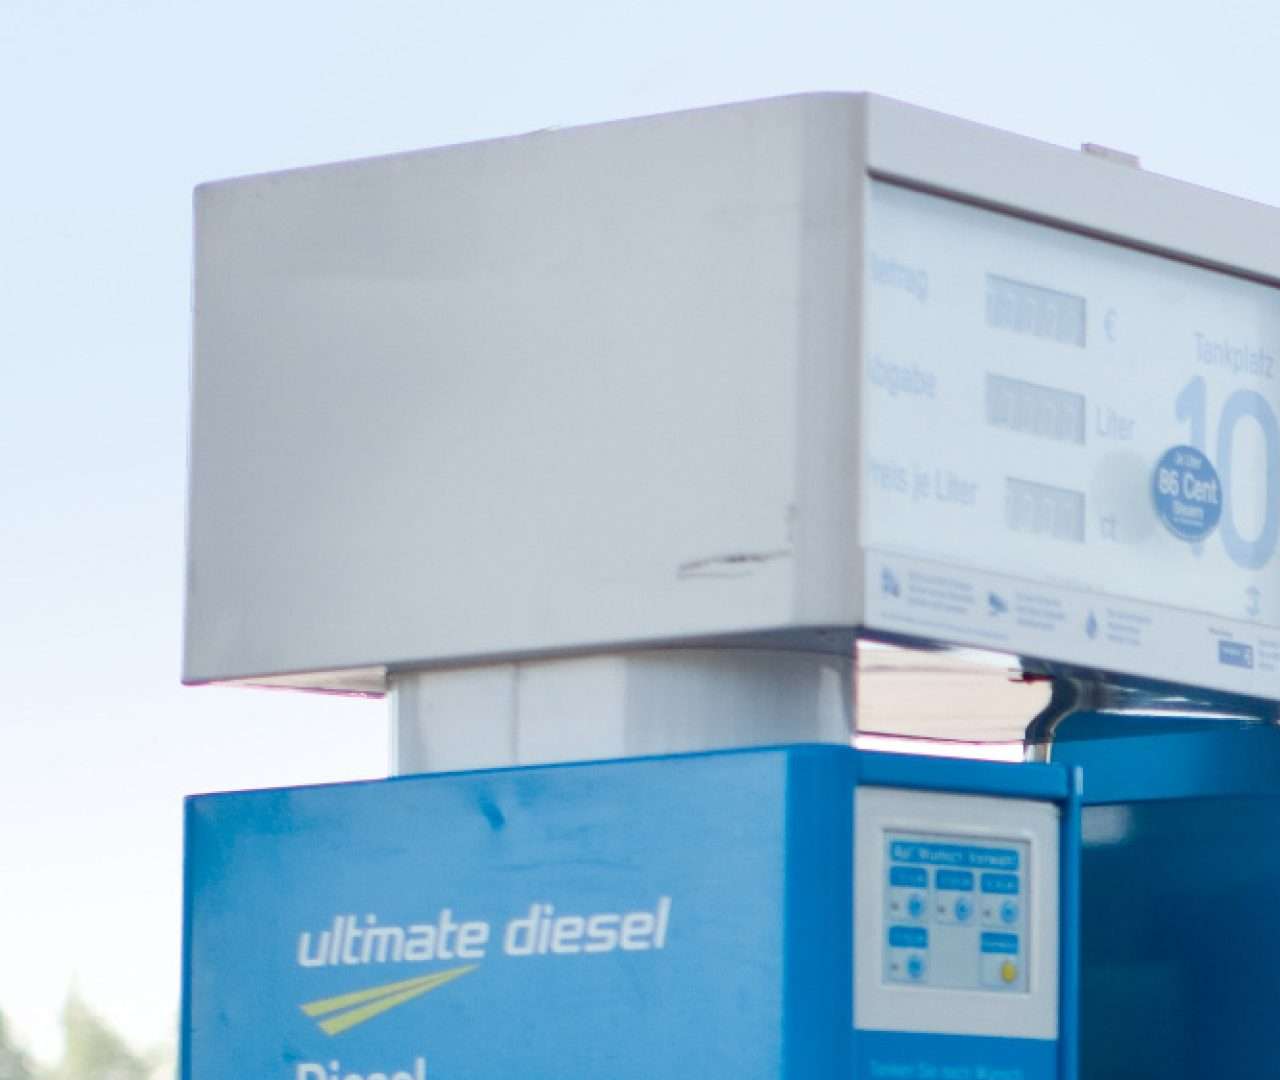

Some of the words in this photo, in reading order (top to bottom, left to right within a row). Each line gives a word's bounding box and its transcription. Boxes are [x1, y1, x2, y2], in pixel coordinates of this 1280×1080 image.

[1193, 331, 1276, 380] Tankplatz
[1182, 472, 1219, 505] Cent
[298, 908, 490, 967] ultimate
[503, 896, 672, 957] diesel
